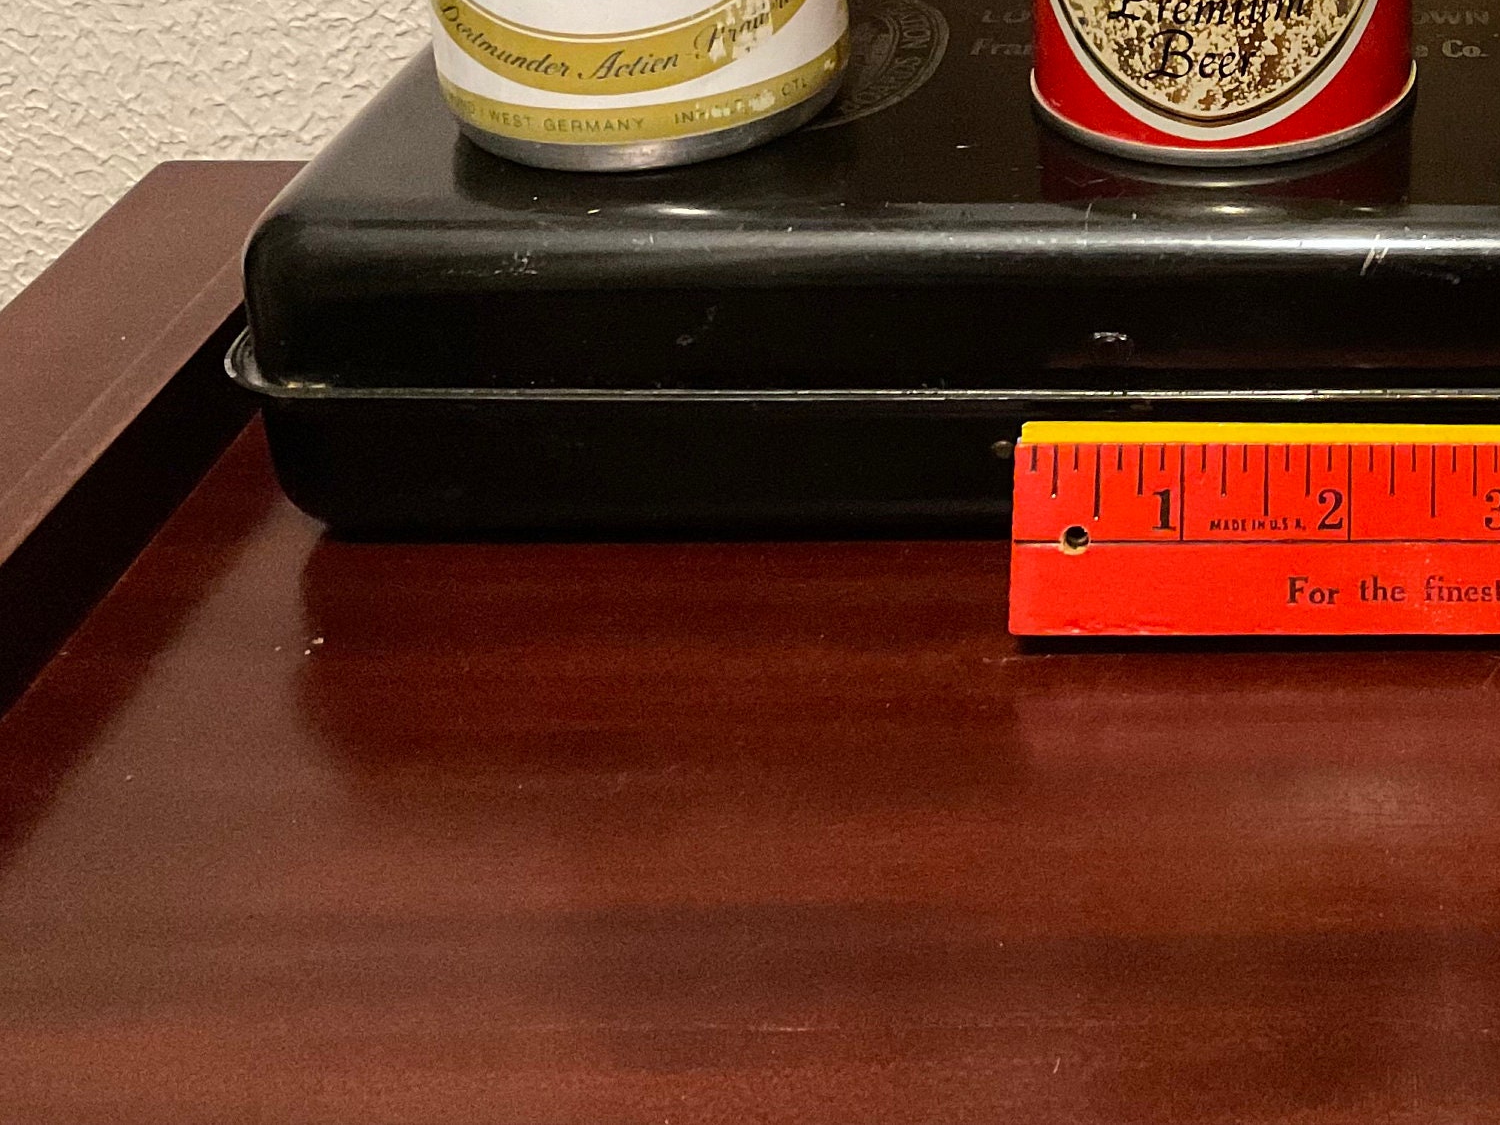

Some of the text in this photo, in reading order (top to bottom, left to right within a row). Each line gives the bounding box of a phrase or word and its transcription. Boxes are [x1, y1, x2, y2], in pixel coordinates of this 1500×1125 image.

[1144, 29, 1260, 81] Beer
[489, 109, 533, 127] WEST
[543, 117, 645, 134] GERMANY
[1151, 488, 1176, 532] 1
[1317, 488, 1344, 531] 2
[1209, 519, 1247, 531] MADE
[1251, 520, 1266, 531] IN
[1287, 576, 1340, 605] For
[1359, 577, 1406, 603] the
